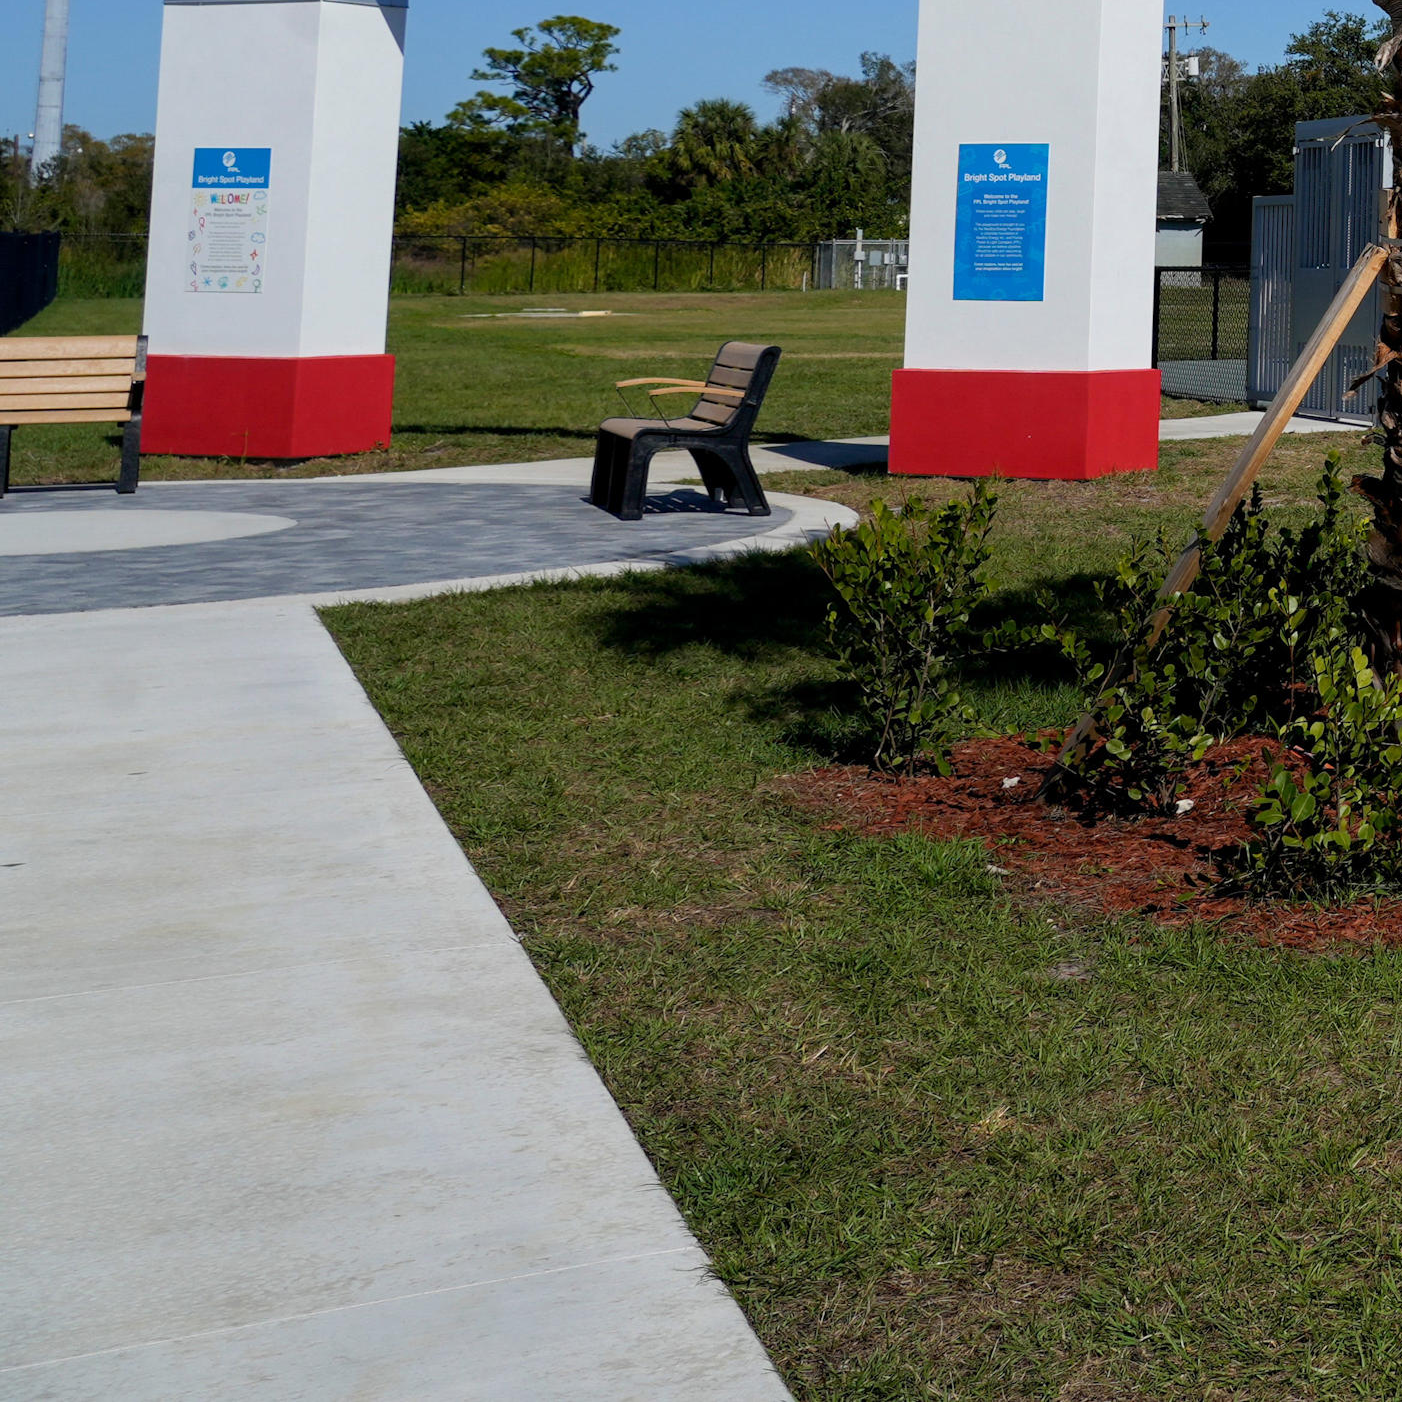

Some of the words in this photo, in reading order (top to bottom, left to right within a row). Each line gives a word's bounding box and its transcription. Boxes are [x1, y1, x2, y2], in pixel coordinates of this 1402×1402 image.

[198, 175, 218, 185] Bright
[219, 175, 235, 184] Spot
[236, 175, 265, 184] Playland
[964, 173, 987, 183] Bright
[988, 173, 1007, 182] Spot
[1008, 173, 1041, 182] Playland
